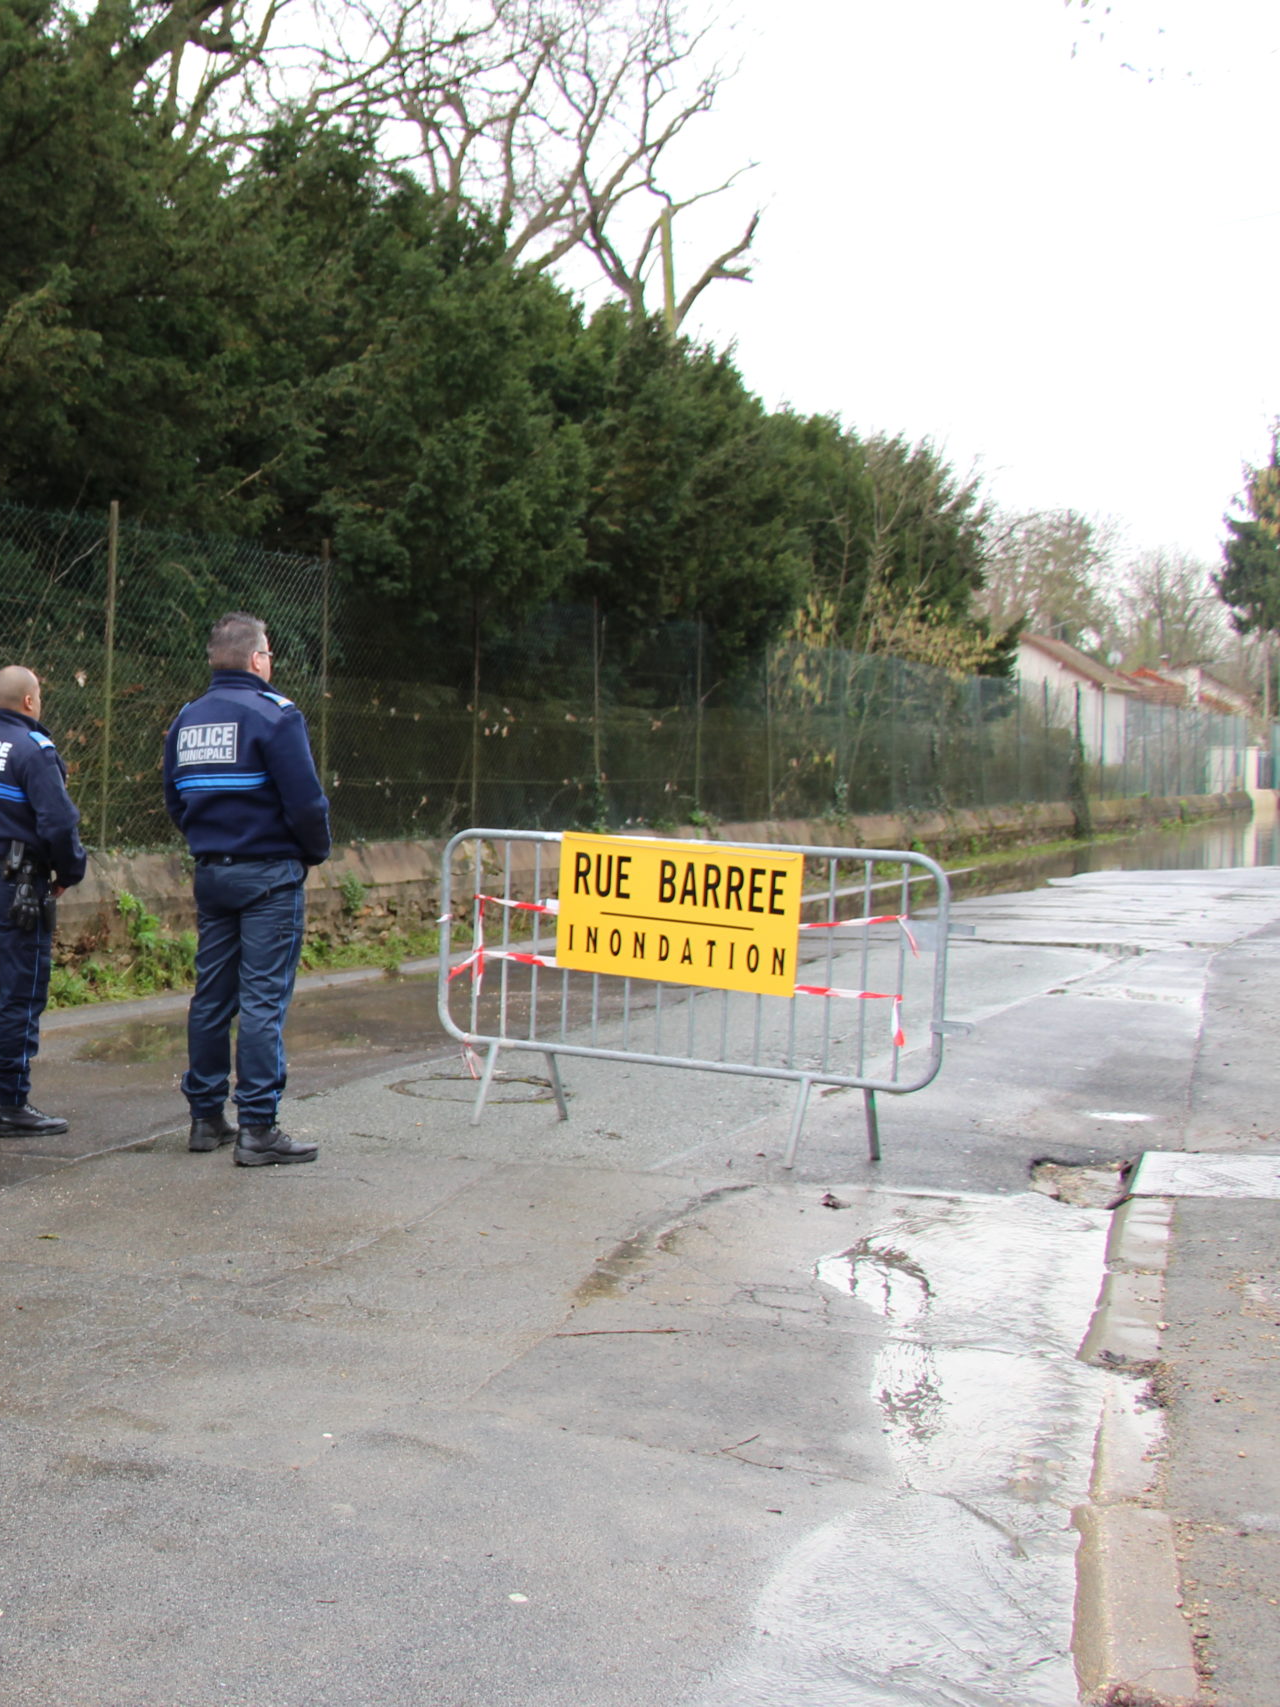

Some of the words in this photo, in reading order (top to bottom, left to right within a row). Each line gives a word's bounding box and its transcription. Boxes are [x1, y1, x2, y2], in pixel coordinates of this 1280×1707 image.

[179, 747, 233, 763] MUNICIPALE
[180, 726, 234, 750] POLICE
[573, 851, 632, 899] RUE
[658, 859, 788, 915] BARREE
[568, 924, 786, 976] INONDATION
